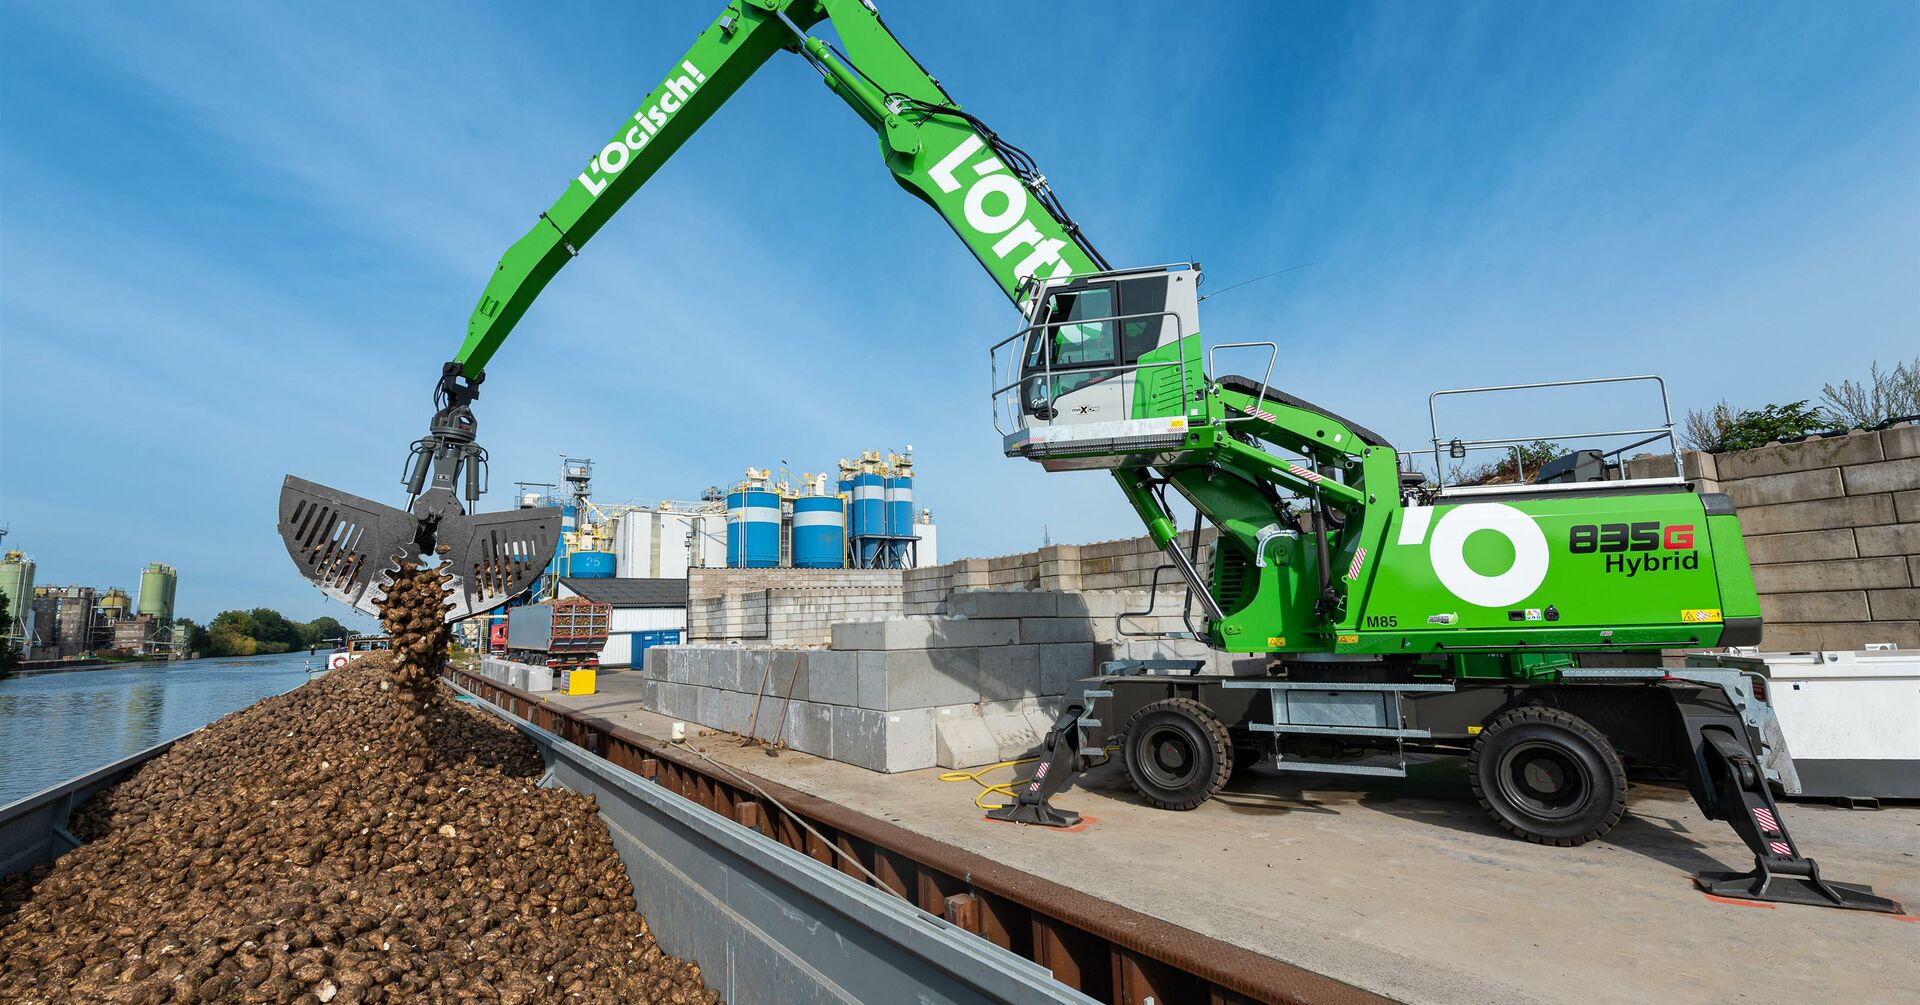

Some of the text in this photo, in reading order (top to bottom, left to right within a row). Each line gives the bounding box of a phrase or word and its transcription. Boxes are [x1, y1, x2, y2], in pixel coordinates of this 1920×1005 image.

[1569, 521, 1694, 554] 835G
[1605, 550, 1699, 578] Hybrid
[1366, 616, 1398, 628] M85
